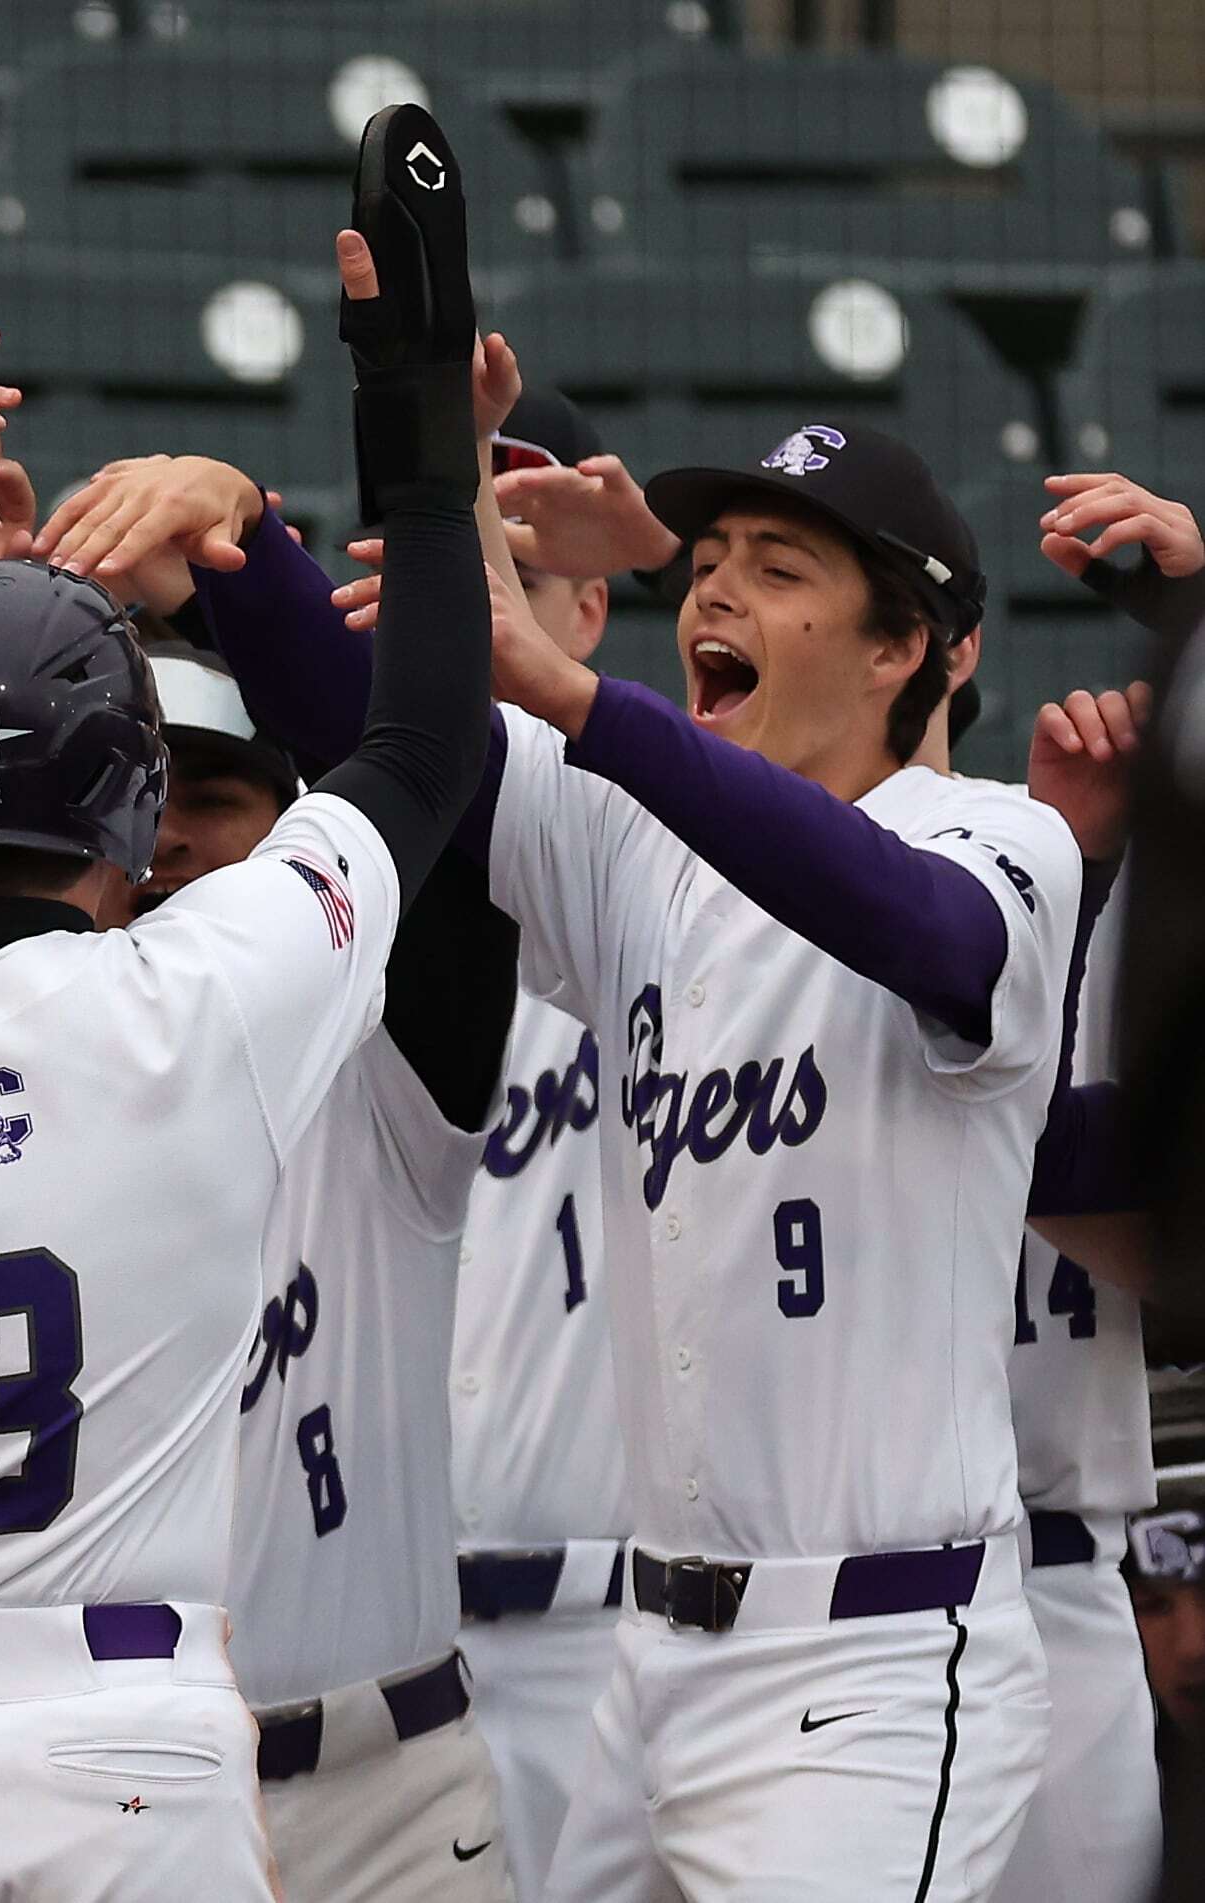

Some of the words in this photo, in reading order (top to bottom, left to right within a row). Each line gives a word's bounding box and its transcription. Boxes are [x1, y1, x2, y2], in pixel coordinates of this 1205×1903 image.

[556, 1192, 587, 1314] 1
[773, 1197, 825, 1318] 9
[296, 1402, 347, 1539] 8
